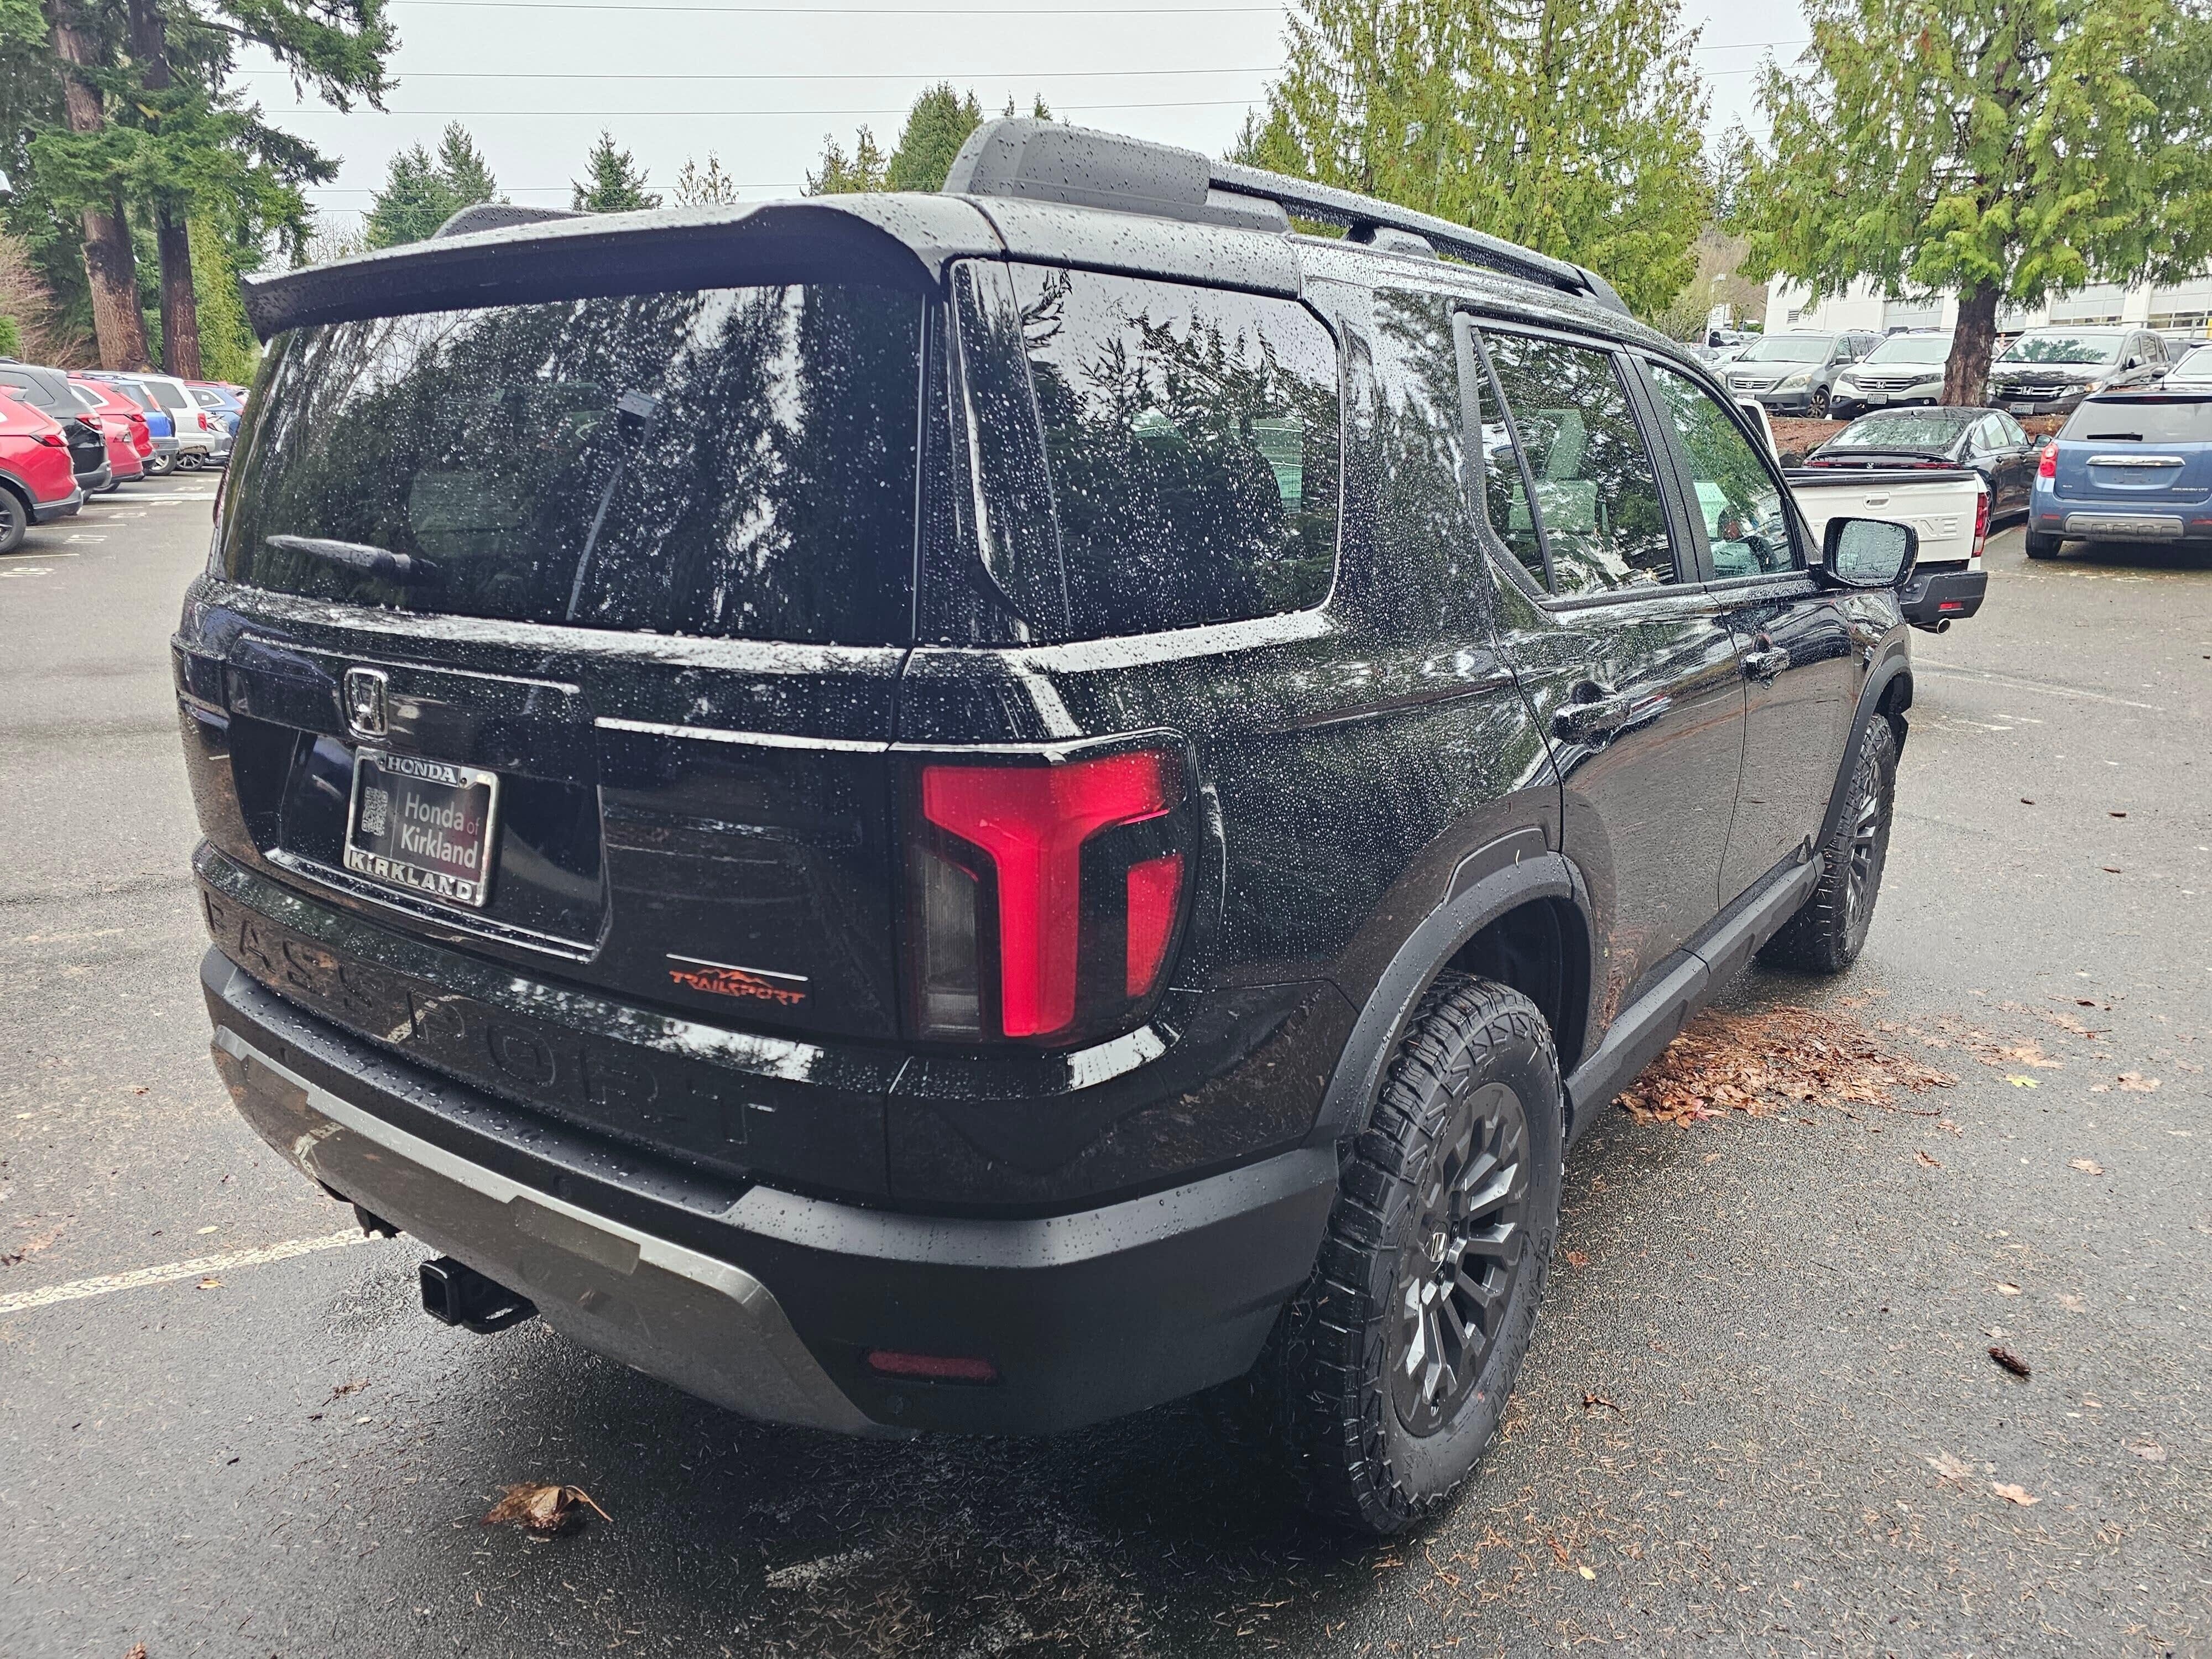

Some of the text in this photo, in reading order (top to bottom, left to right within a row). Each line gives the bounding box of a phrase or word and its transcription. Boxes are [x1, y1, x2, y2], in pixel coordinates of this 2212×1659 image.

[388, 756, 457, 784] HONDA
[405, 791, 480, 835] Honda of
[401, 824, 478, 869] Kirkland
[351, 852, 473, 900] KIRKLAND
[669, 969, 806, 1005] TRAILSPORT
[203, 888, 780, 1146] PASSPORT
